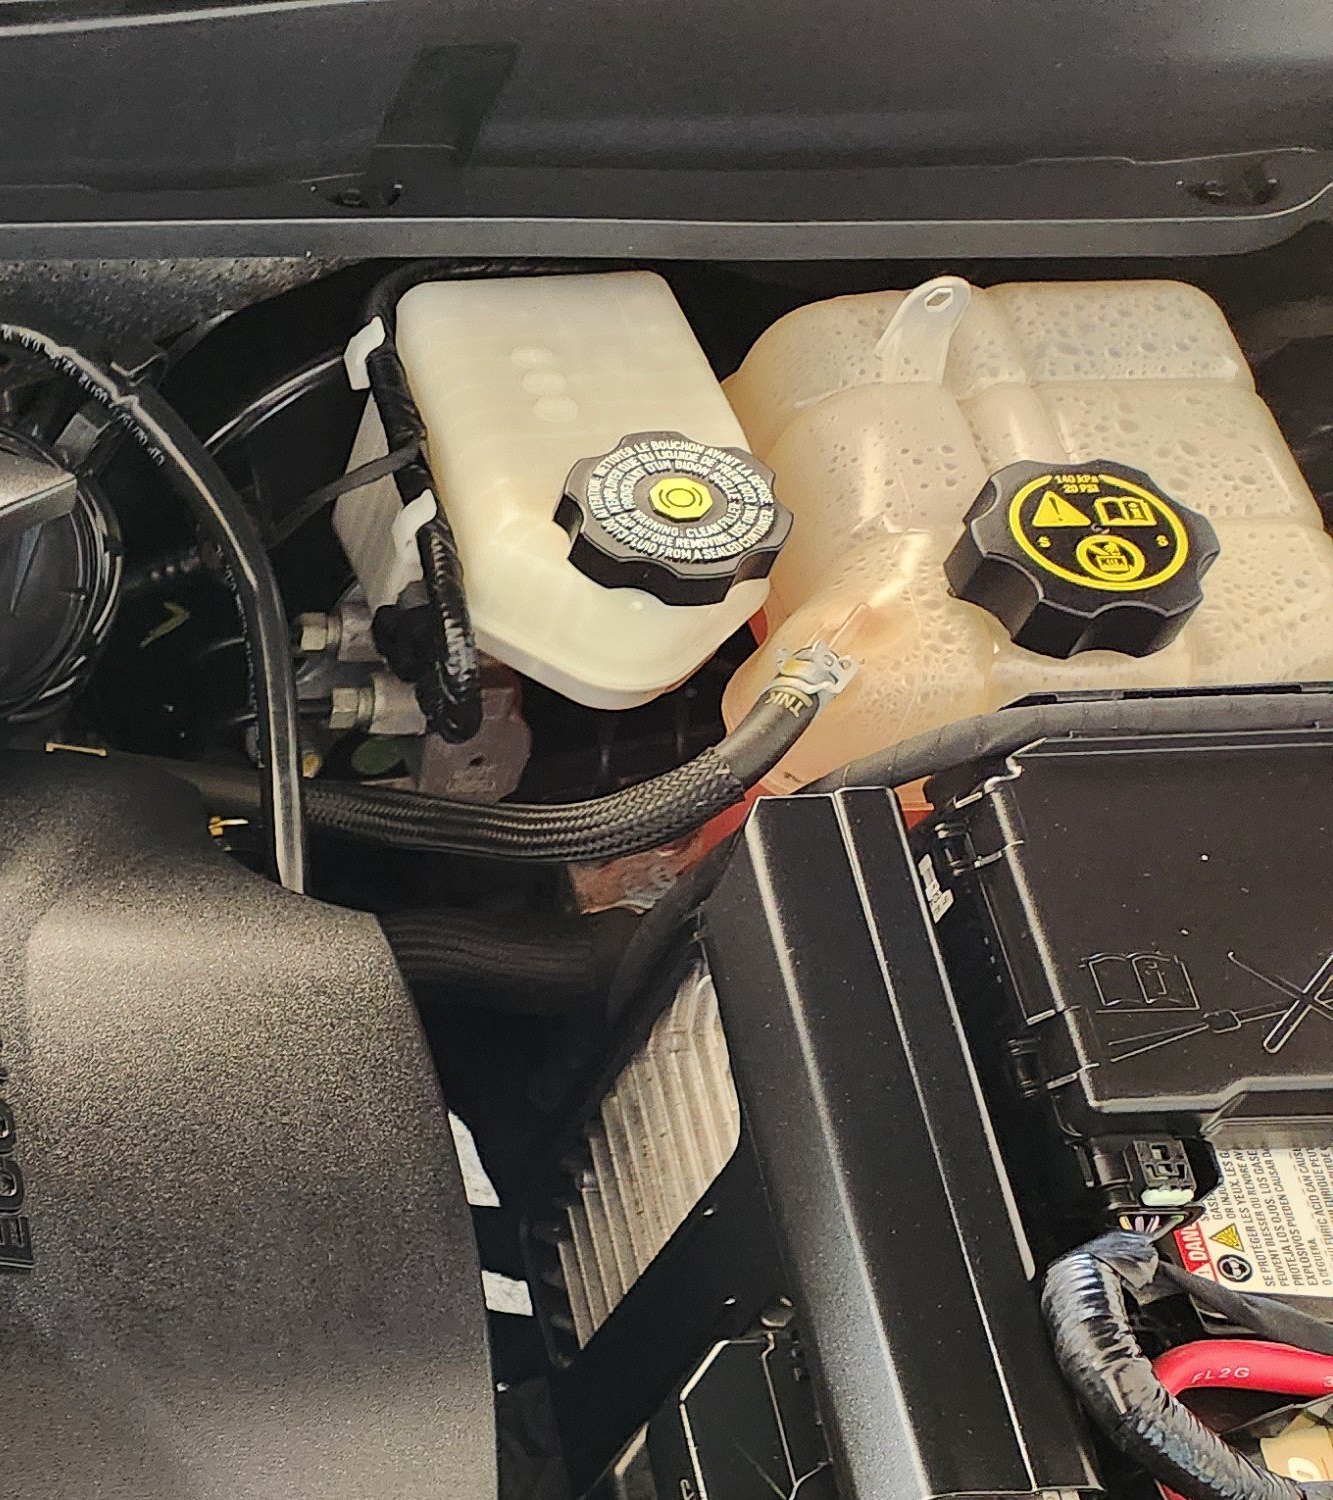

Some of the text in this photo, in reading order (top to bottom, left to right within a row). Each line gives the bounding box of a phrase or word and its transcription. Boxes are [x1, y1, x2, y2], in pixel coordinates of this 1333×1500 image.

[634, 442, 651, 453] LE
[650, 440, 705, 454] BOUCHON
[704, 447, 743, 467] AVANT
[735, 464, 753, 477] LA
[637, 452, 656, 463] DU
[700, 455, 717, 467] DE
[674, 459, 710, 477] BIDON
[1054, 474, 1075, 484] 140
[1063, 484, 1100, 494] 20 PSI
[615, 512, 637, 529] CAP
[630, 524, 675, 546] BEFORE
[727, 520, 751, 538] USE
[685, 522, 723, 538] CLEAN
[622, 534, 659, 554] FLUID
[657, 545, 692, 560] FROM
[701, 541, 744, 560] SEALED
[764, 691, 804, 718] TNK
[1222, 1161, 1236, 1176] LES
[1246, 1149, 1264, 1174] GASE
[1257, 1177, 1271, 1194] LOS
[1265, 1160, 1284, 1192] CAUSAR
[1303, 1176, 1316, 1192] CAN
[1217, 1184, 1236, 1219] OR INJU
[1250, 1198, 1261, 1208] OU
[1278, 1195, 1295, 1227] PUEDEN
[1309, 1195, 1324, 1215] ACID
[1239, 1208, 1253, 1223] LES
[1180, 1223, 1208, 1262] DAN
[1274, 1226, 1289, 1242] LOS
[1282, 1245, 1303, 1285] PROTEJA
[1289, 1230, 1317, 1285] EXPLOSIVOS
[1268, 1250, 1287, 1286] PEUVENT
[1263, 1276, 1275, 1286] SE
[1191, 1367, 1251, 1384] FL2G
